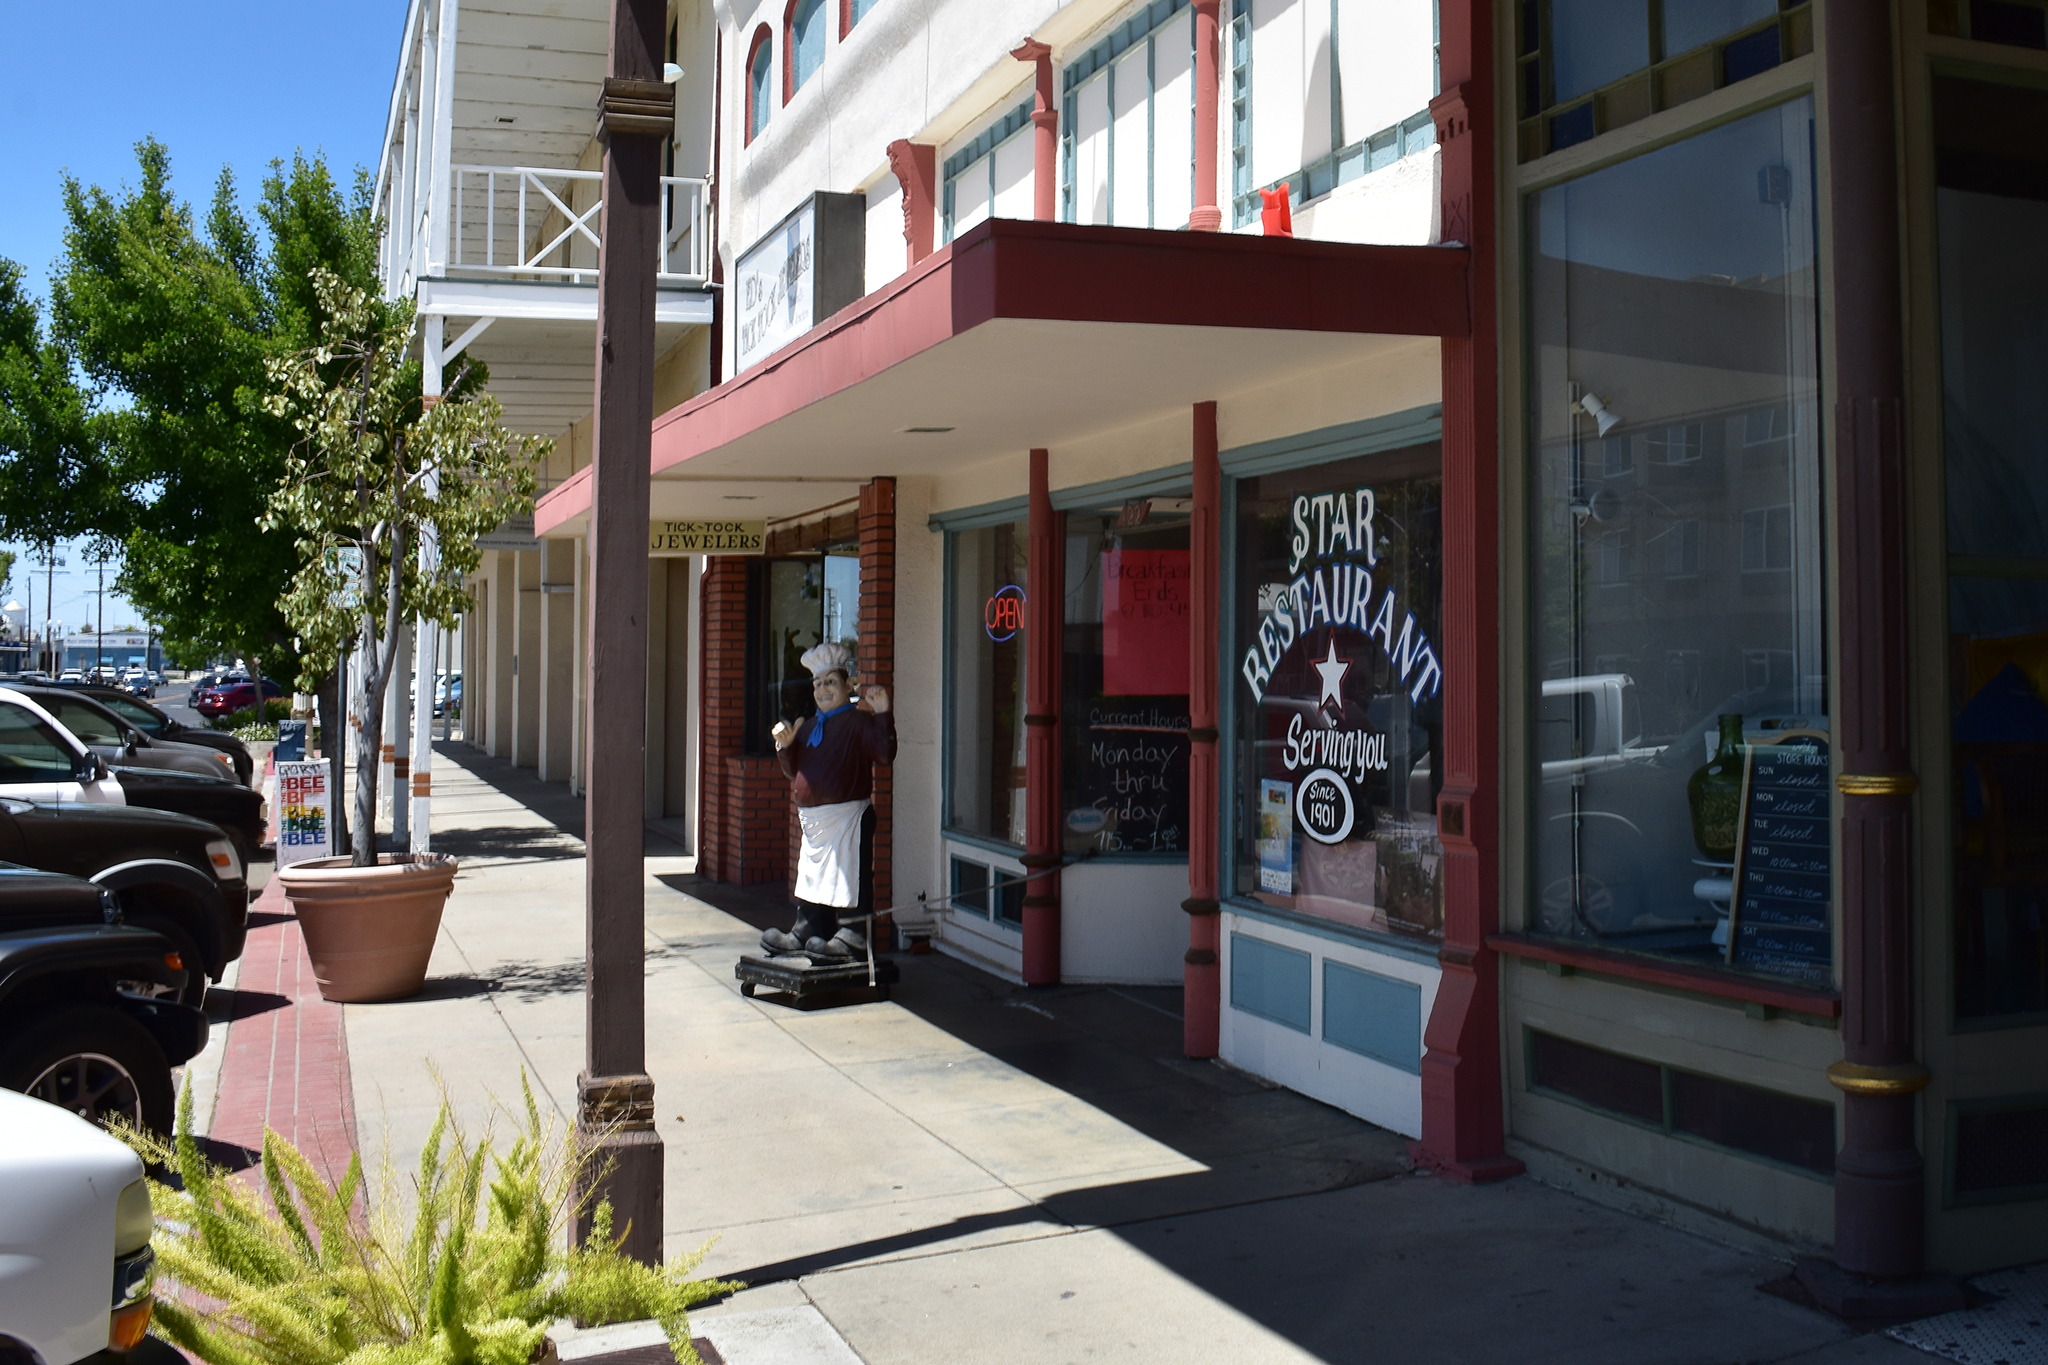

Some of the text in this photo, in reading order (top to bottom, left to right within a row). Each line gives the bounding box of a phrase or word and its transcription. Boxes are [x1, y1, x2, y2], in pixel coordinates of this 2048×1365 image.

[664, 521, 745, 533] TICK-TOCK
[1289, 486, 1377, 575] STAR
[651, 534, 761, 549] JEWELERS
[985, 596, 1025, 630] OPEN
[1242, 562, 1443, 706] RESTAURANT
[1089, 707, 1190, 729] Current Hours
[1282, 712, 1388, 784] Serving you
[1091, 738, 1178, 774] Monday
[1777, 752, 1828, 767] STORE HOURS
[1758, 766, 1774, 775] SUN
[287, 776, 325, 789] BEE
[1111, 768, 1170, 794] thru
[1776, 773, 1820, 787] closed
[1309, 782, 1336, 802] Since
[1756, 792, 1774, 802] MON
[1772, 799, 1816, 814] closed
[1310, 802, 1335, 828] 1901
[1754, 819, 1769, 828] TUE
[288, 831, 326, 845] BEE
[1769, 825, 1814, 840] closed
[1751, 846, 1769, 855] WED
[1749, 872, 1764, 882] THU
[1746, 900, 1758, 909] FRI
[1743, 926, 1757, 936] SAT
